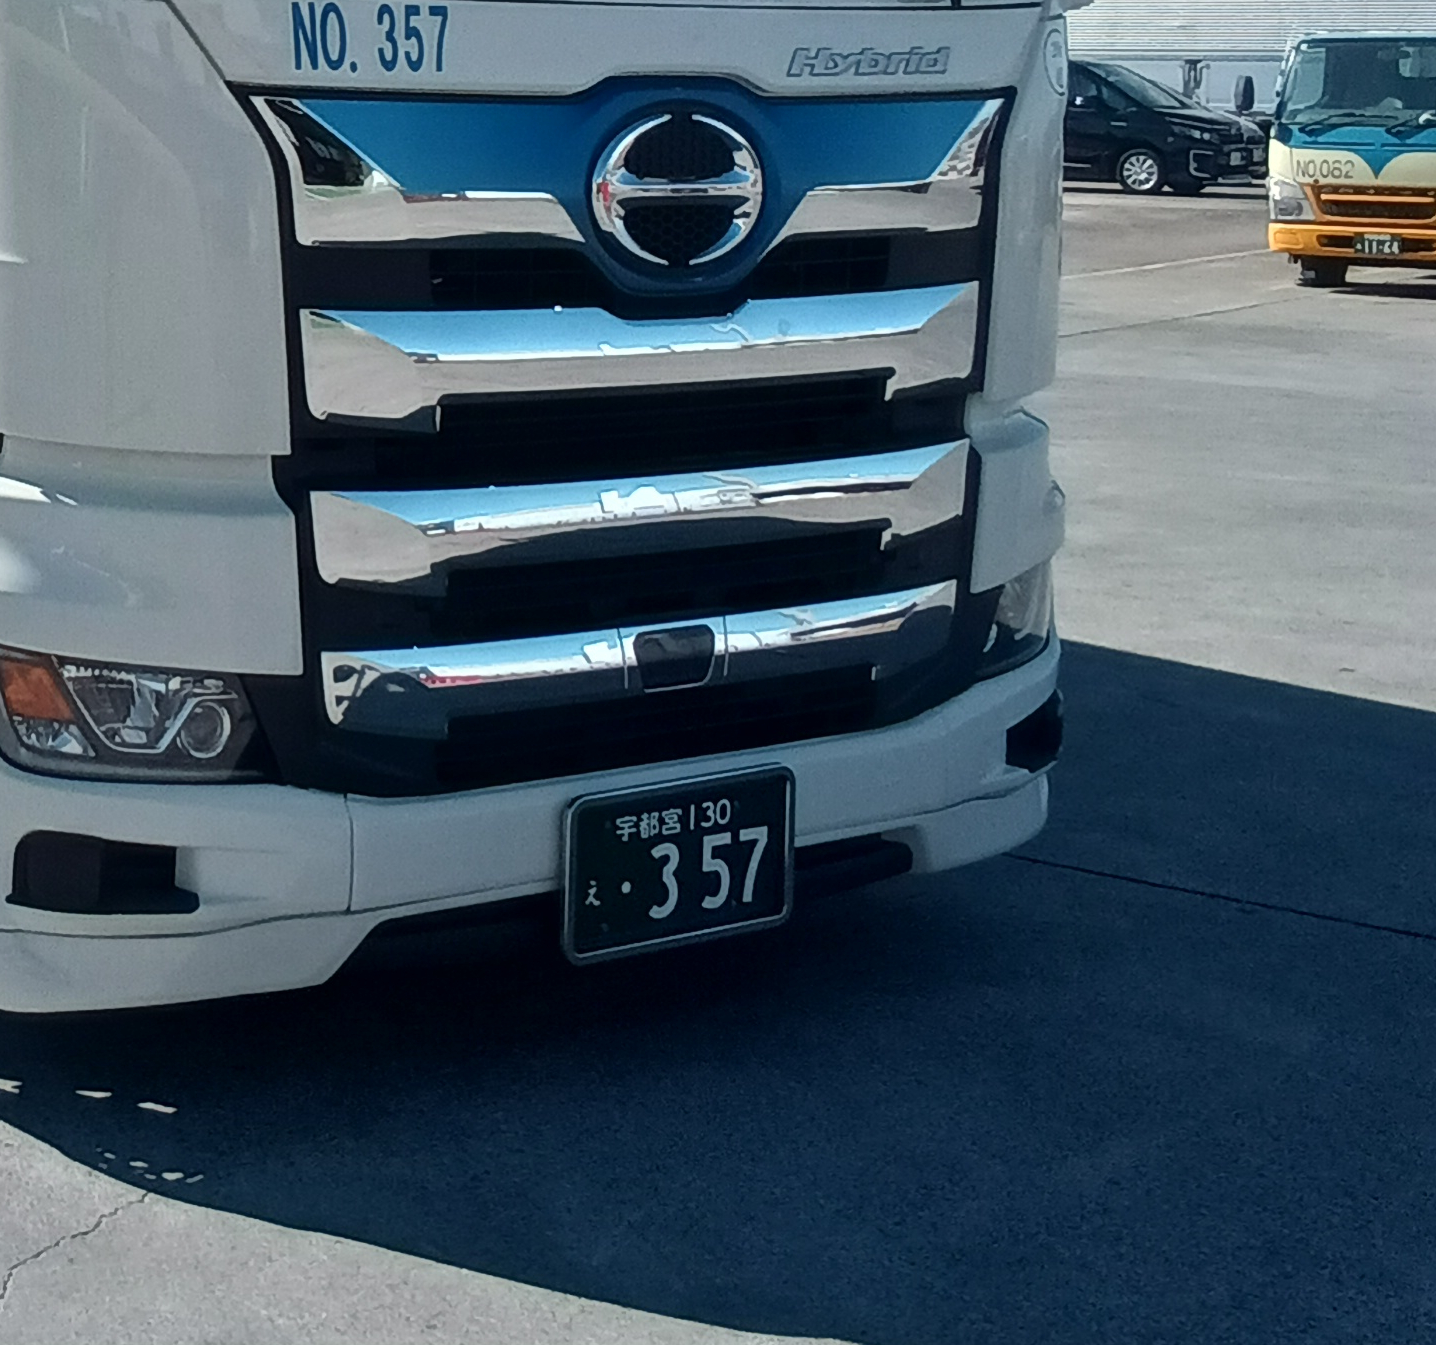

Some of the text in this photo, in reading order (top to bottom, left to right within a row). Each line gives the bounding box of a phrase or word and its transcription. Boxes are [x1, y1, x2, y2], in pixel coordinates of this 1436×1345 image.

[290, 0, 450, 76] NO. 357
[786, 46, 951, 78] Hybrid
[615, 798, 732, 842] 宇都宮 130
